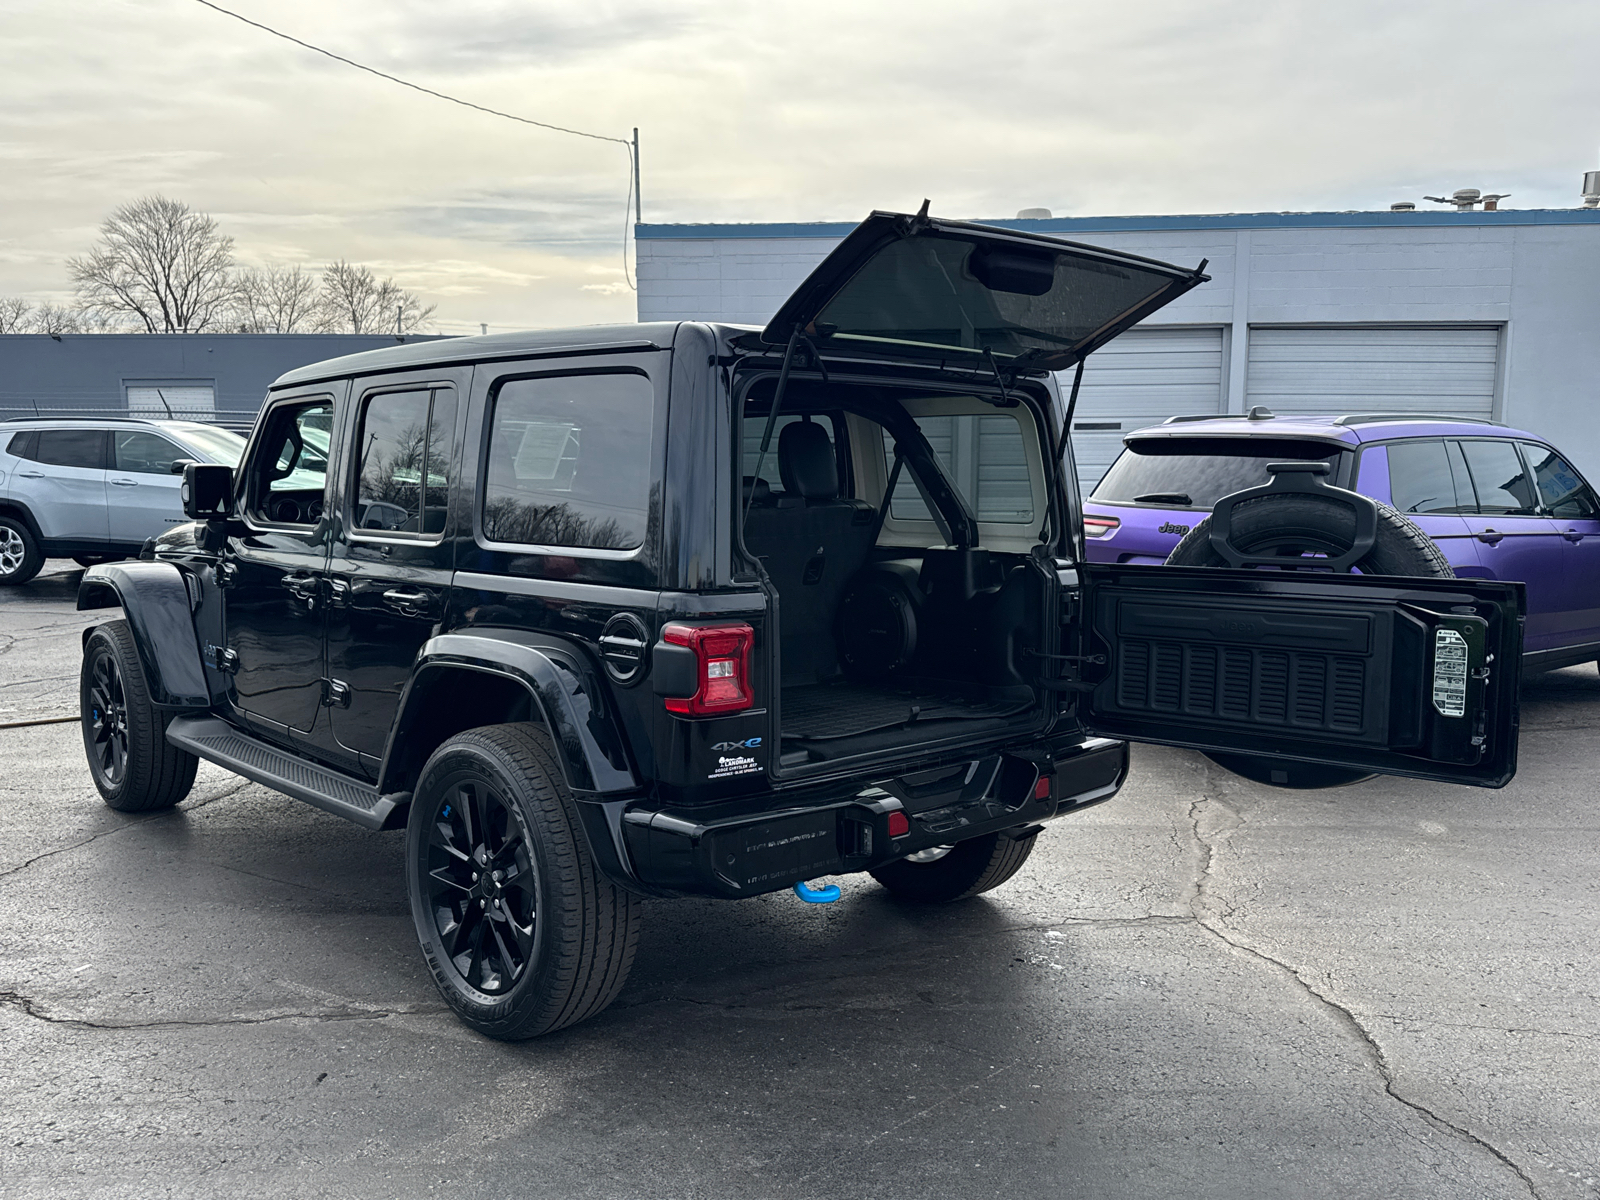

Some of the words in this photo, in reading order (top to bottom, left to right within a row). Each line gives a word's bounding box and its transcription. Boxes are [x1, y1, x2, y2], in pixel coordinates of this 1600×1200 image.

[1158, 522, 1189, 537] Jeep
[724, 757, 755, 767] LANDMARK
[707, 771, 733, 779] INDEPENDENCE
[714, 766, 728, 774] DODGE
[422, 941, 514, 1020] BRIDGESTONE
